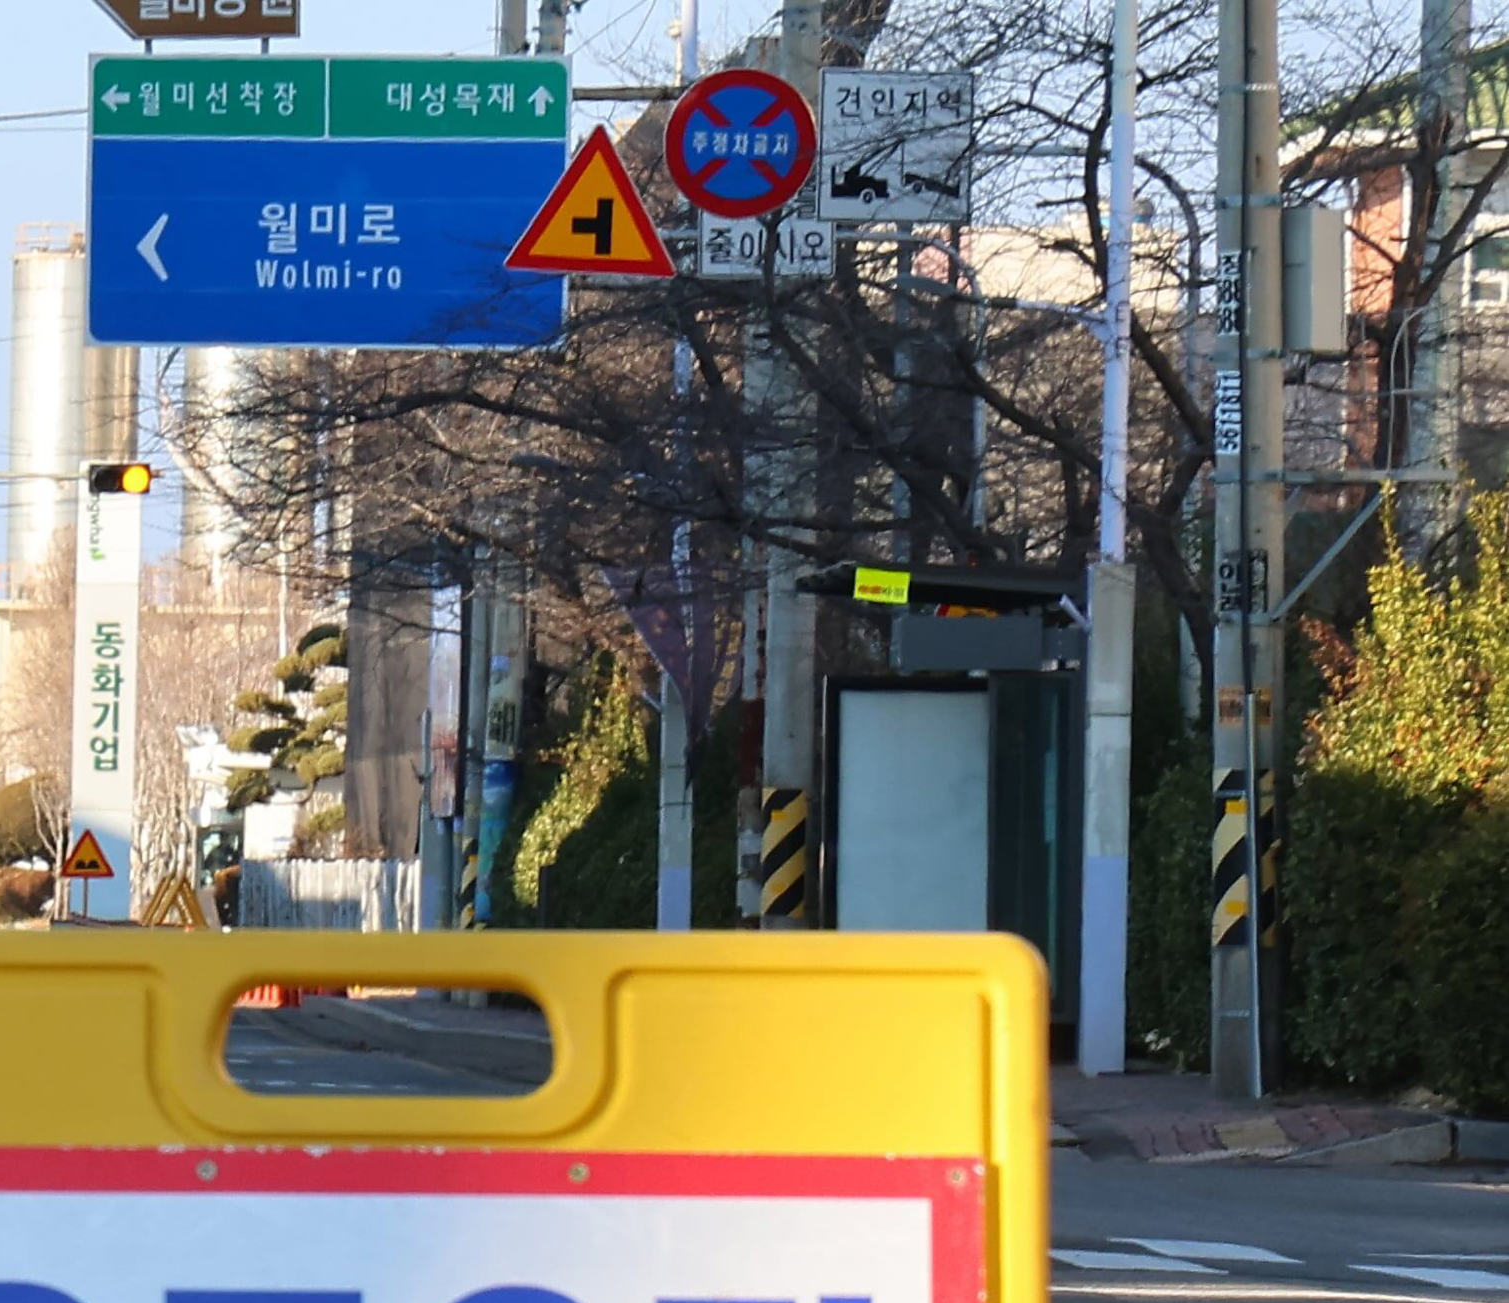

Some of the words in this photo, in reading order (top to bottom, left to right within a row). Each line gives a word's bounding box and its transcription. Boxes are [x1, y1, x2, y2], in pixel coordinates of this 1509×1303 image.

[138, 81, 298, 117] 월미선착장
[386, 82, 516, 117] 대성목재
[836, 86, 963, 118] 견인지역
[692, 131, 790, 156] 주정차금지
[257, 202, 402, 252] 월미로
[256, 261, 402, 290] Wolmi-ro
[91, 622, 125, 772] 동화기업
